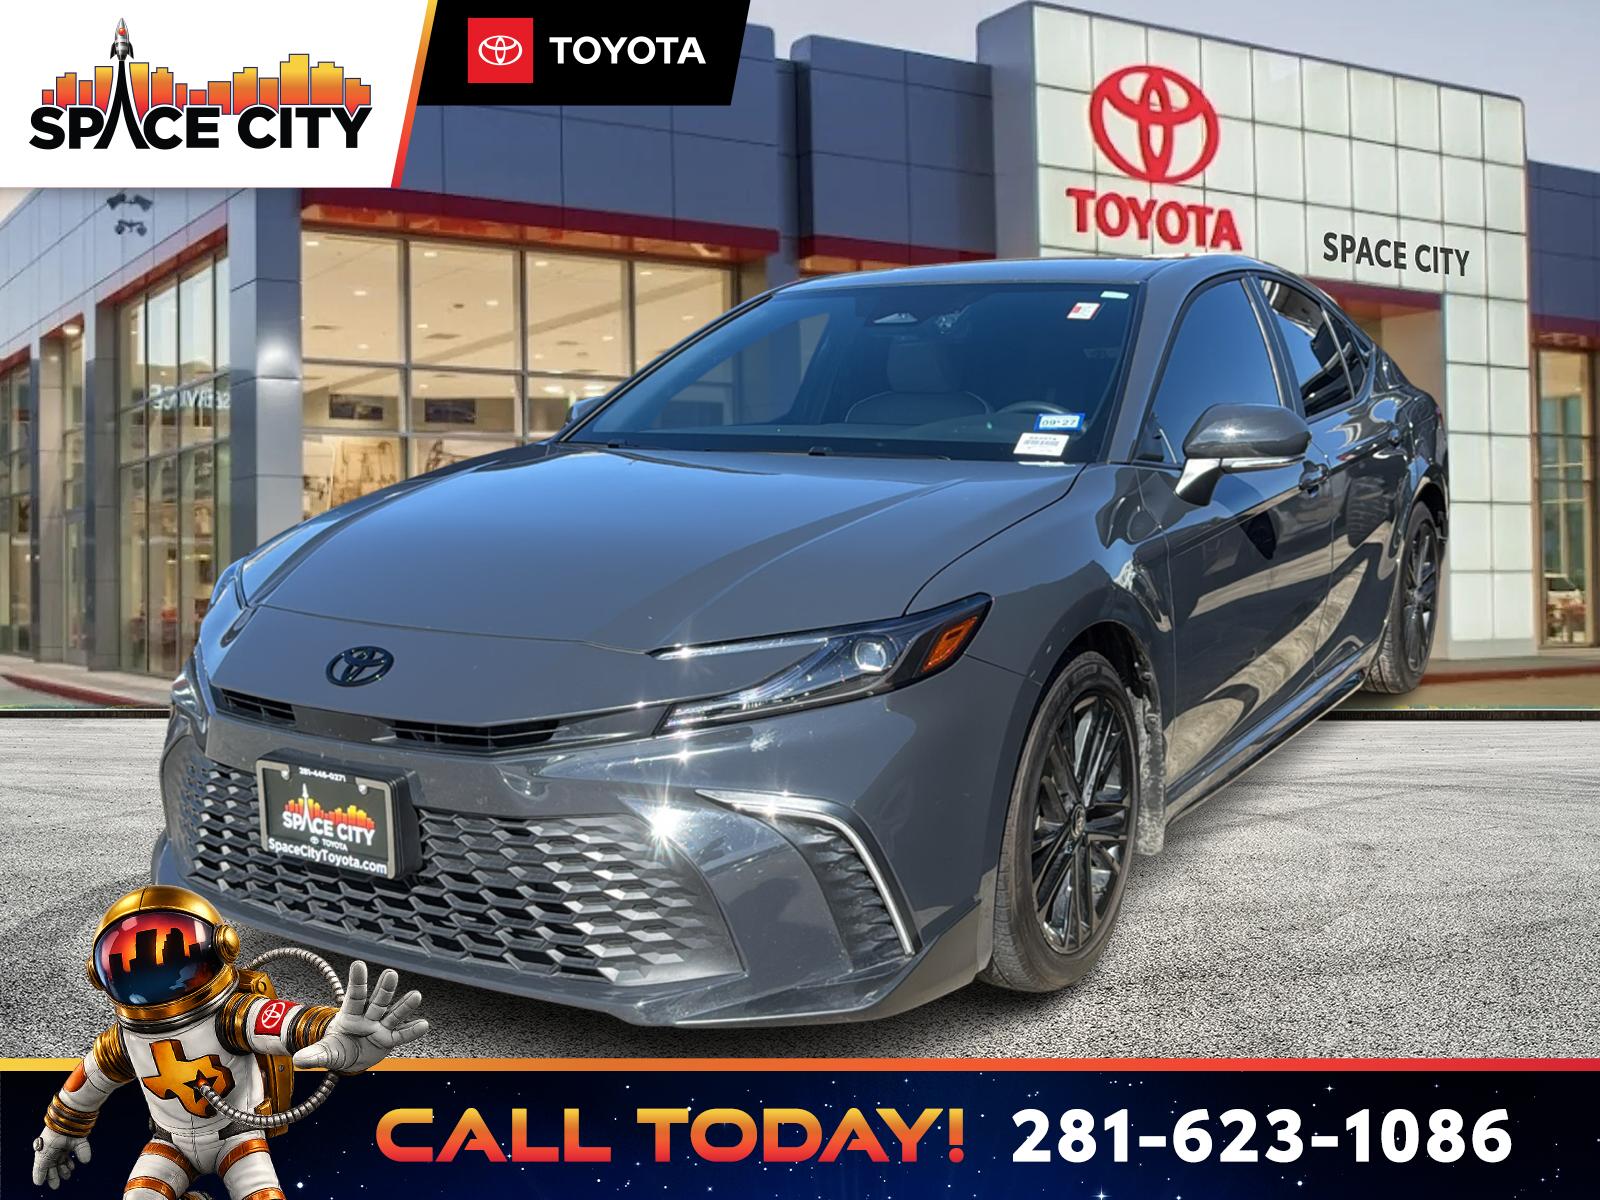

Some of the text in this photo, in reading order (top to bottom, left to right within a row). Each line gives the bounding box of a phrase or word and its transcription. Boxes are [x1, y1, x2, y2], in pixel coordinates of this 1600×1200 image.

[1065, 187, 1243, 251] TOYOTA
[1323, 231, 1471, 276] SPACE CITY
[282, 811, 375, 846] SPACE CITY
[322, 838, 348, 851] TOYOTA
[268, 837, 387, 874] SpaceCityToyota.com
